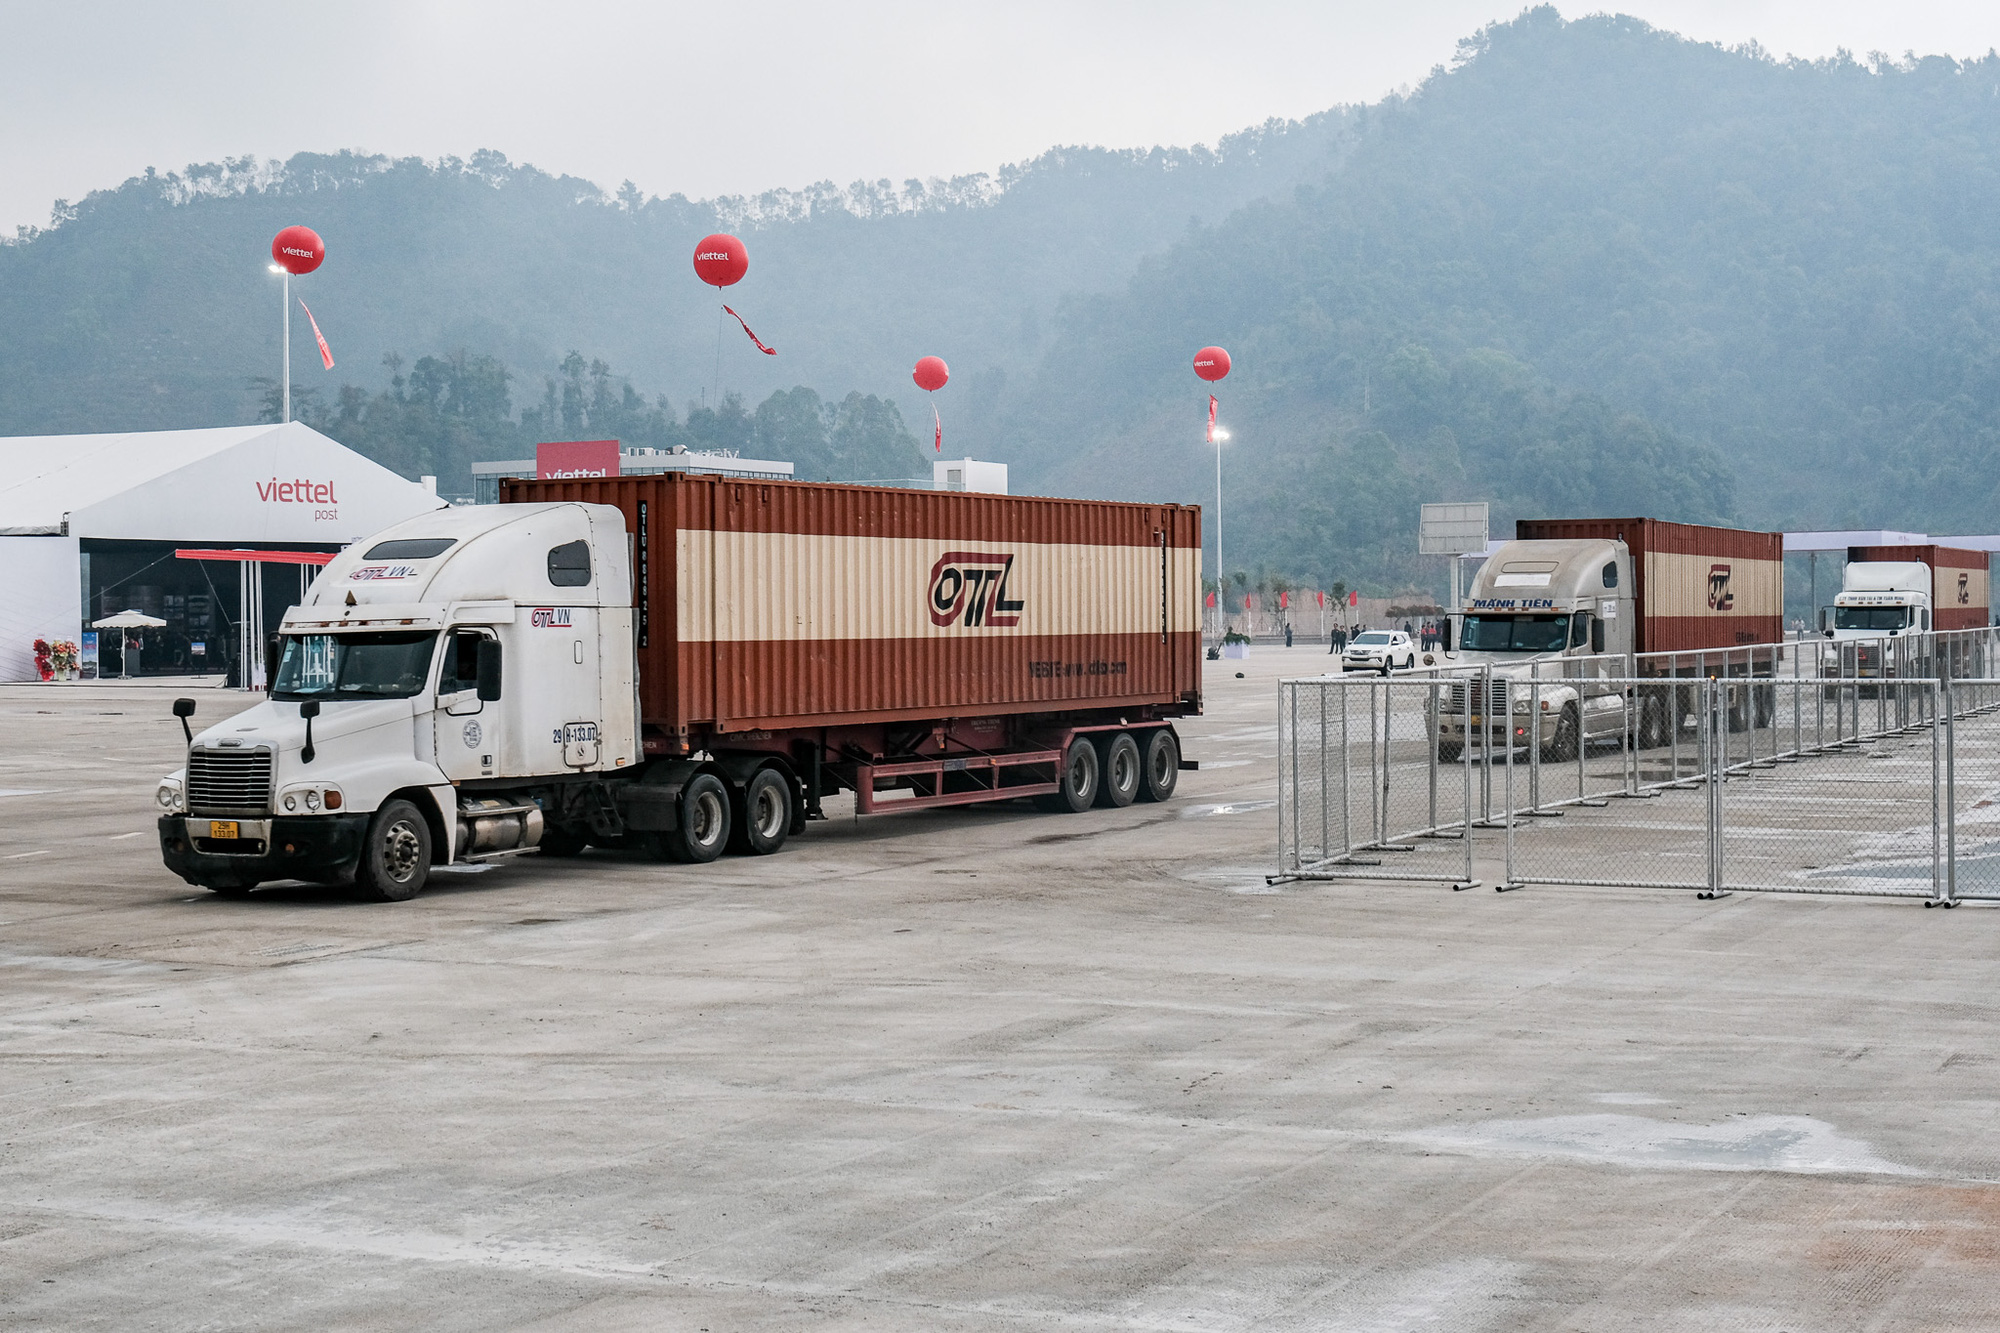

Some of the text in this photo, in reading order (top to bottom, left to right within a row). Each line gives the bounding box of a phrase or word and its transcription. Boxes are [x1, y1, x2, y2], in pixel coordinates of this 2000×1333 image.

[281, 246, 314, 259] viettel
[696, 252, 729, 261] viettel
[256, 477, 338, 504] viettel
[314, 508, 338, 522] post
[557, 609, 571, 624] VN
